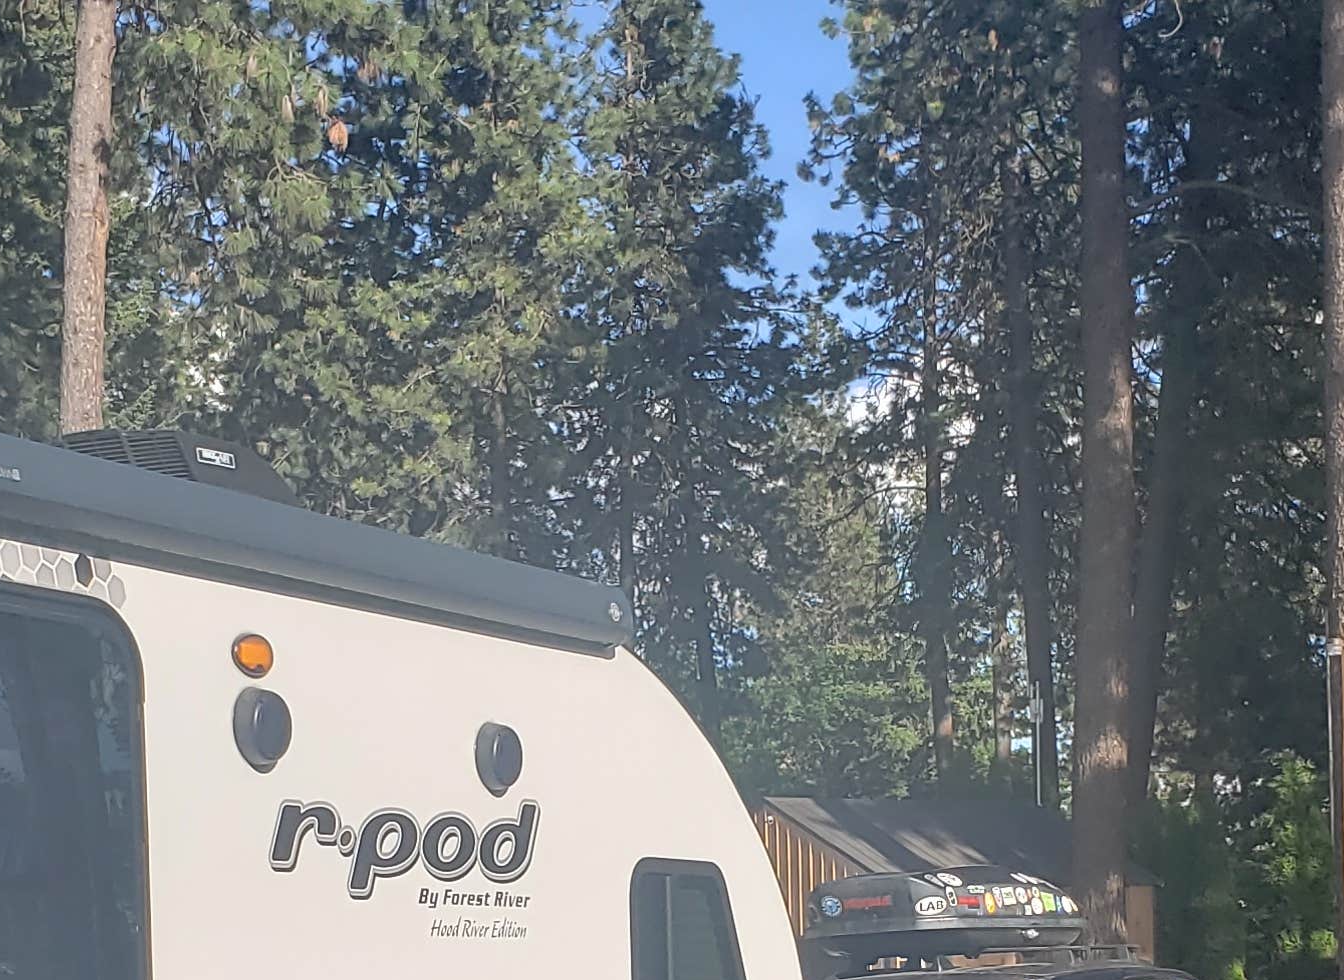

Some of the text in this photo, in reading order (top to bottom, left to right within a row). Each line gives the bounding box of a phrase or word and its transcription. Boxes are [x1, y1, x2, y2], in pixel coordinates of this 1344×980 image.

[418, 888, 531, 909] By Forest River
[919, 900, 945, 912] LAB
[430, 916, 528, 938] Hood River Edition
